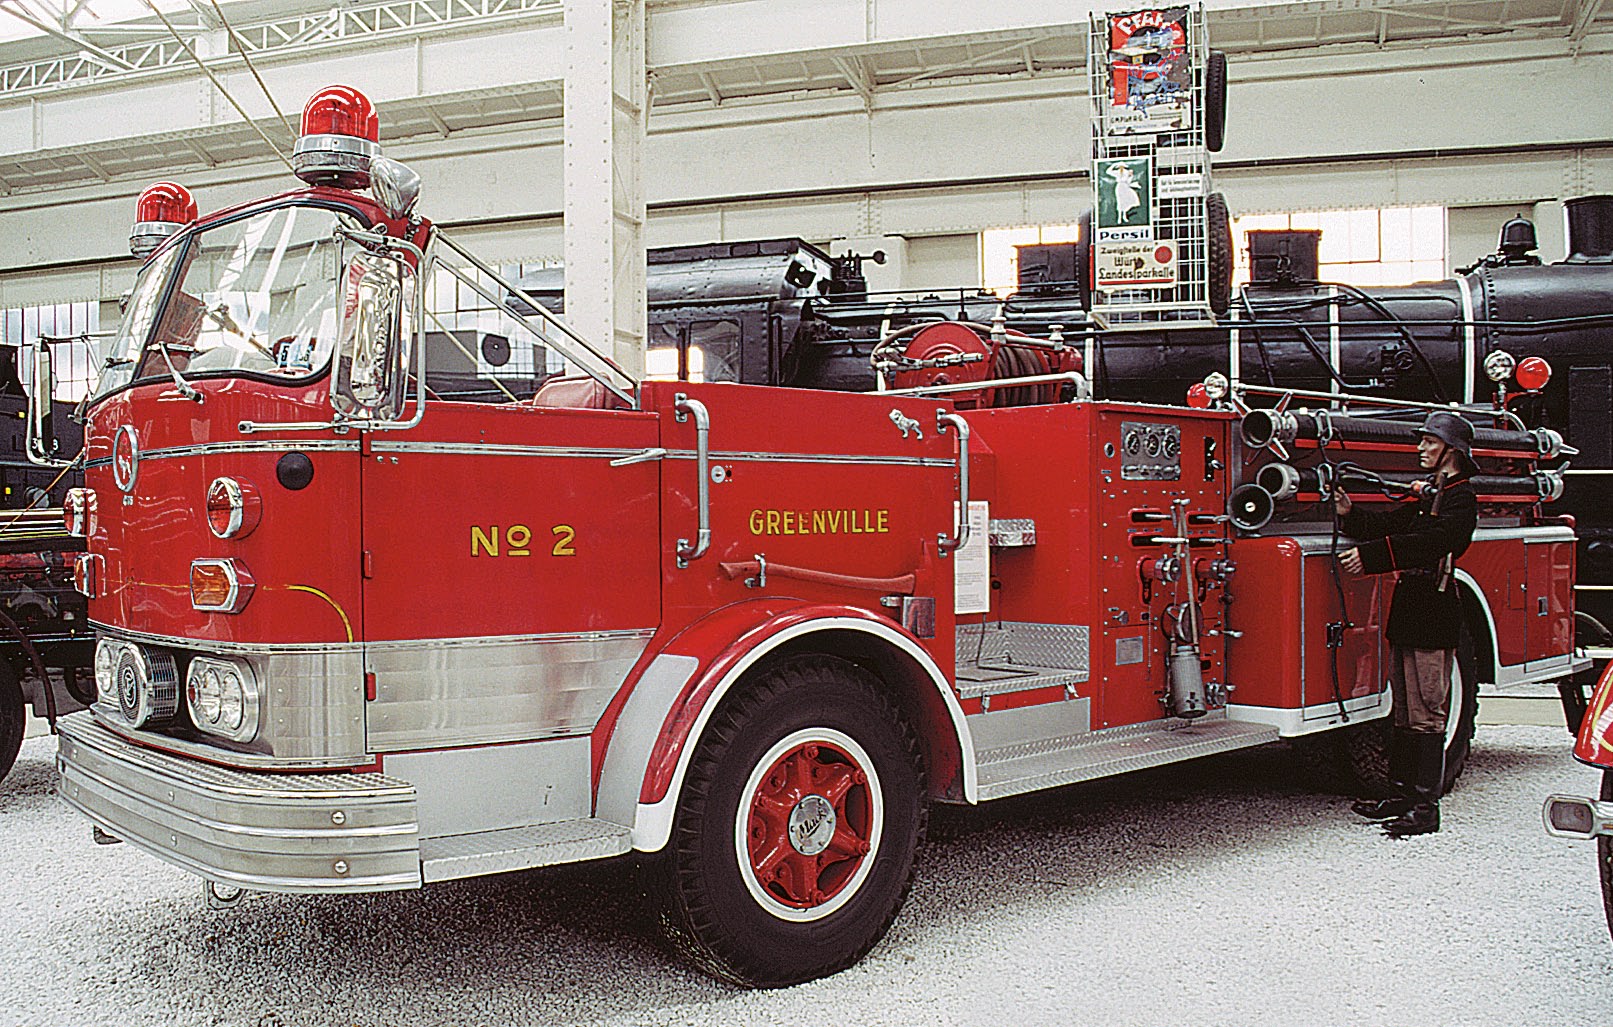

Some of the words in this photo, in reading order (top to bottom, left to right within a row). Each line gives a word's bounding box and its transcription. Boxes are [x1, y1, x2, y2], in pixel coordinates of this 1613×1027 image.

[1100, 229, 1149, 240] Persil
[749, 509, 889, 536] GREENVILLE
[552, 525, 576, 557] 2
